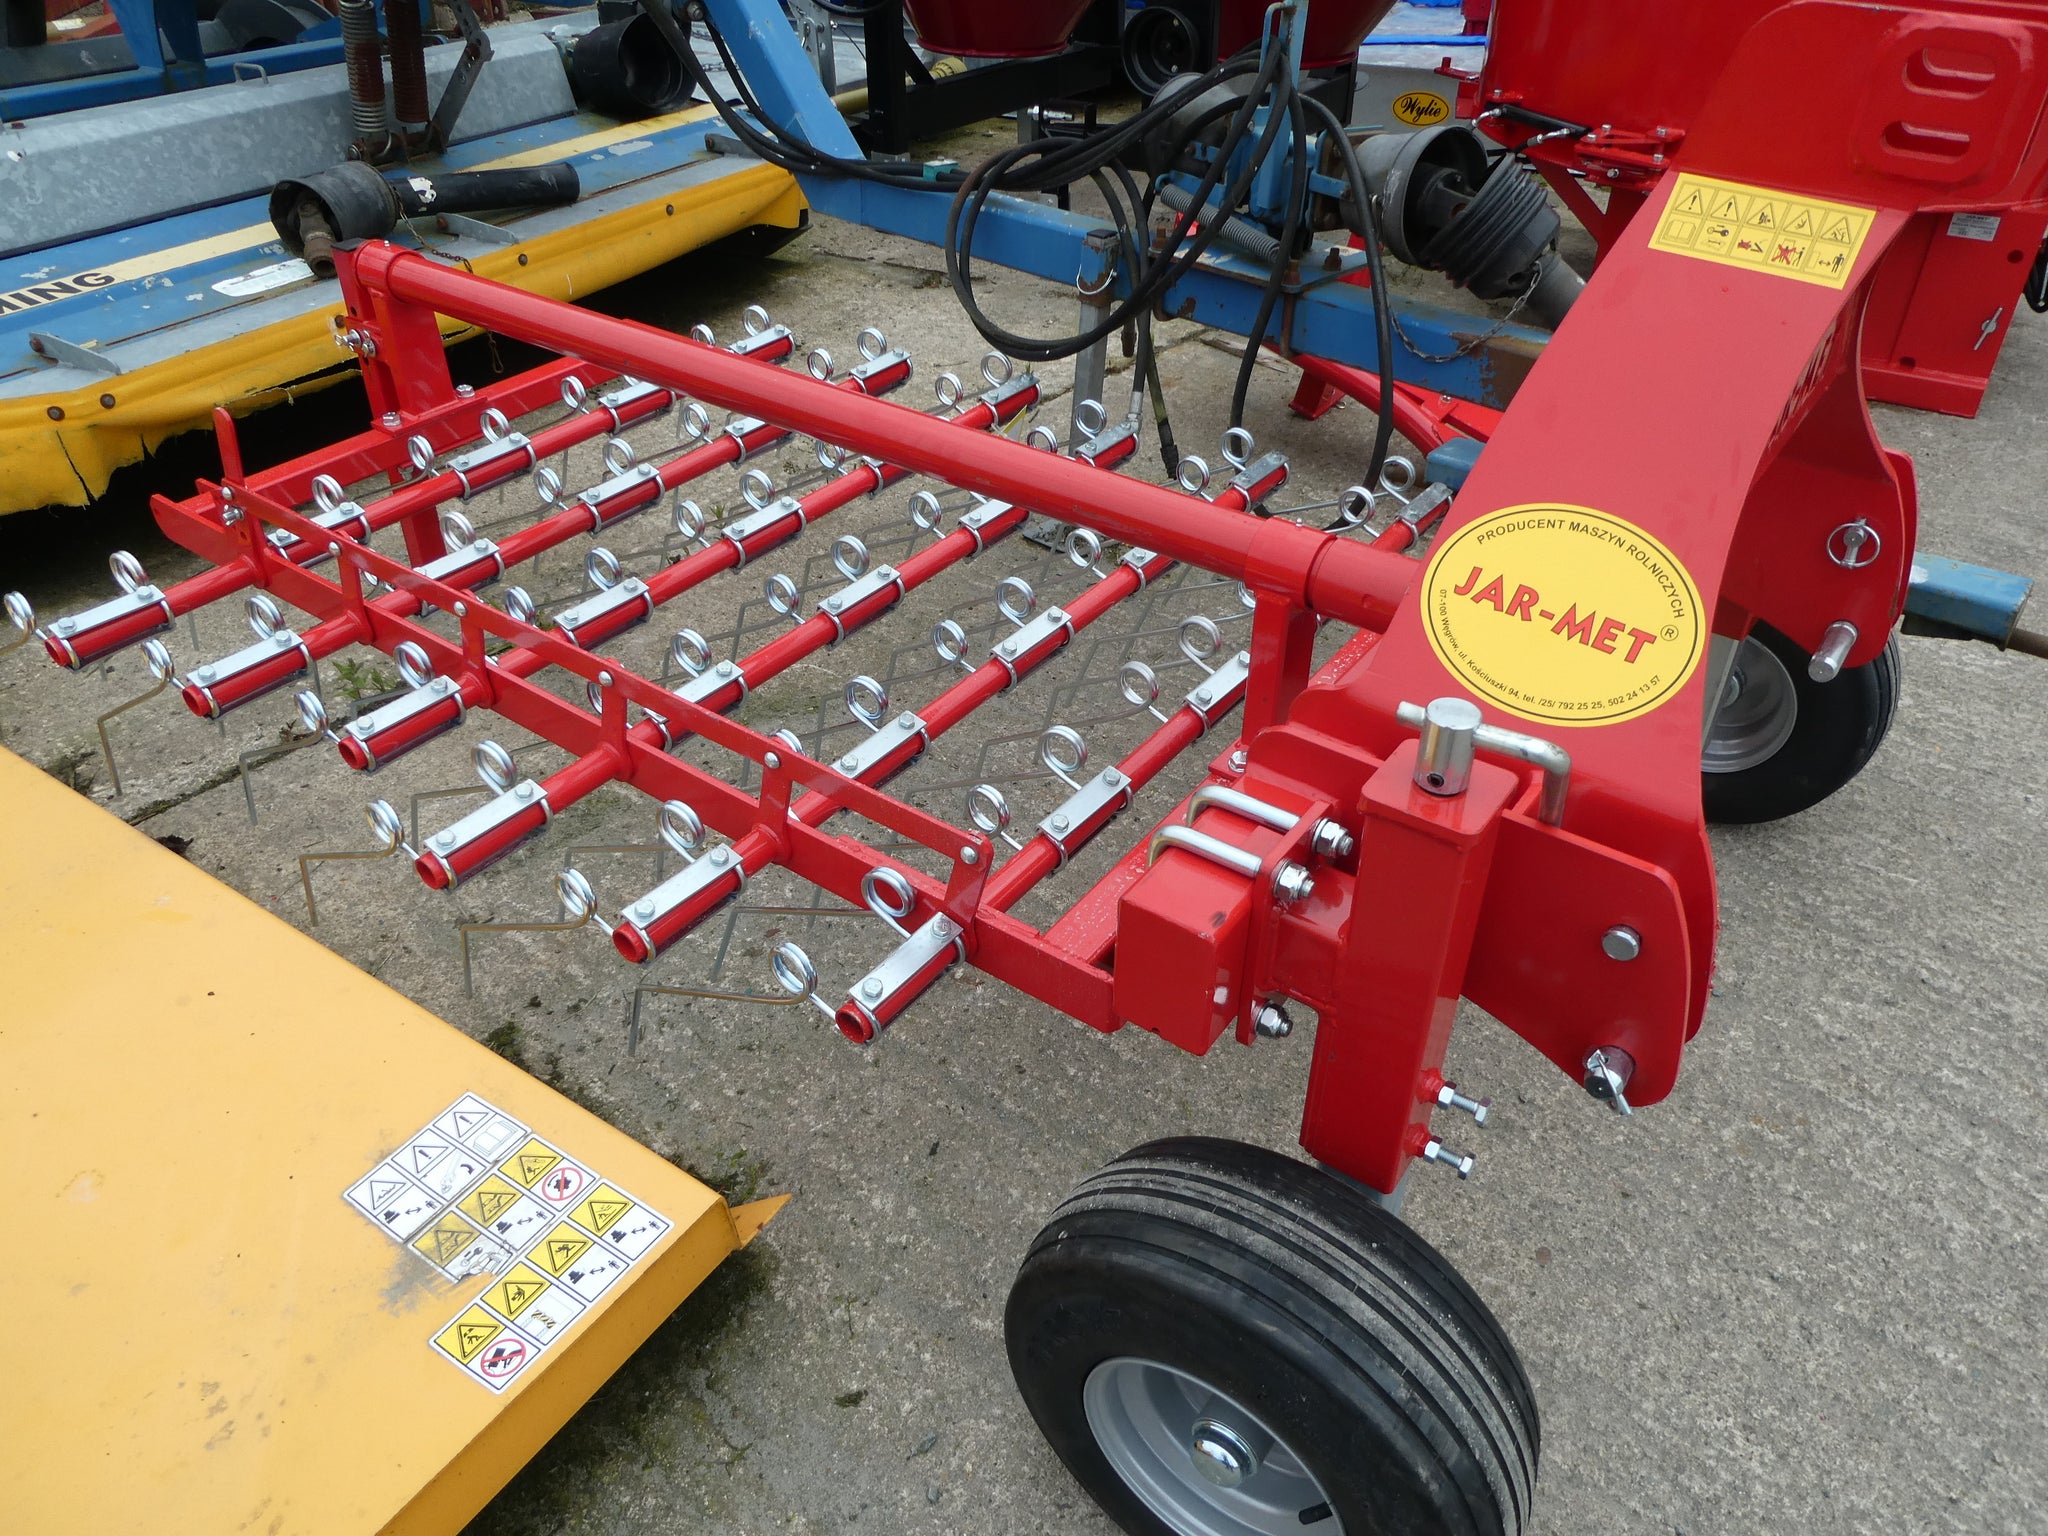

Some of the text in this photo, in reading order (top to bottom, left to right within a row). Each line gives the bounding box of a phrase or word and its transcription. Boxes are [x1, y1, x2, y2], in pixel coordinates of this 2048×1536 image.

[1401, 96, 1441, 122] Wylie
[1476, 519, 1685, 619] PRODUCENT MASZYN ROLNICZYCH
[1453, 566, 1658, 664] JAR-MET
[1467, 659, 1507, 692] Kościuszki
[1508, 687, 1520, 699] 94,
[1523, 694, 1536, 704] tel.
[1538, 698, 1556, 708] /25/
[1558, 701, 1574, 710] 792
[1577, 701, 1588, 710] 25
[1608, 696, 1625, 707] 502
[1627, 690, 1638, 701] 24
[1639, 684, 1650, 694] 13
[1650, 674, 1661, 686] 57
